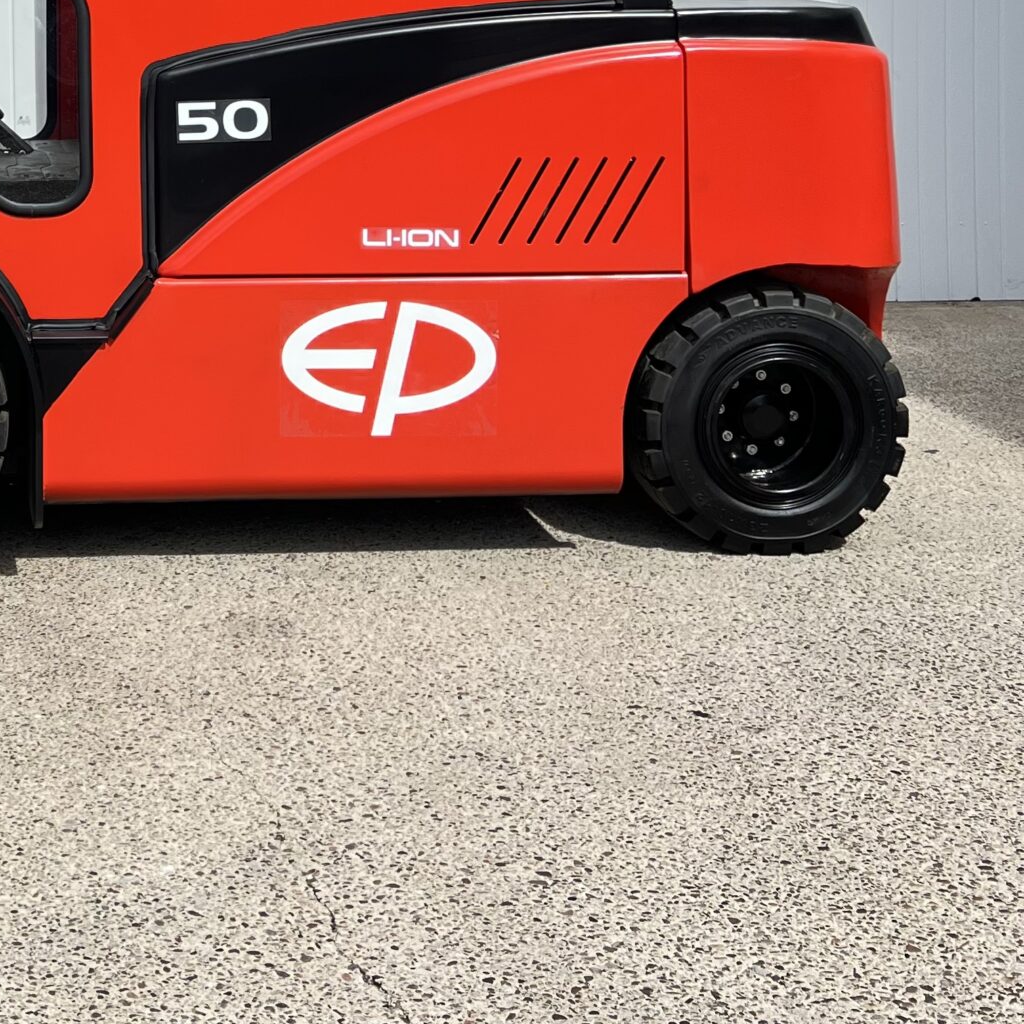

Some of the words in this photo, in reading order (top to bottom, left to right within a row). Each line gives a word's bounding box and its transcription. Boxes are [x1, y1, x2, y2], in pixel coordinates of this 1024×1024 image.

[177, 99, 269, 141] 50
[362, 228, 460, 248] LI-ION
[281, 301, 497, 437] EP
